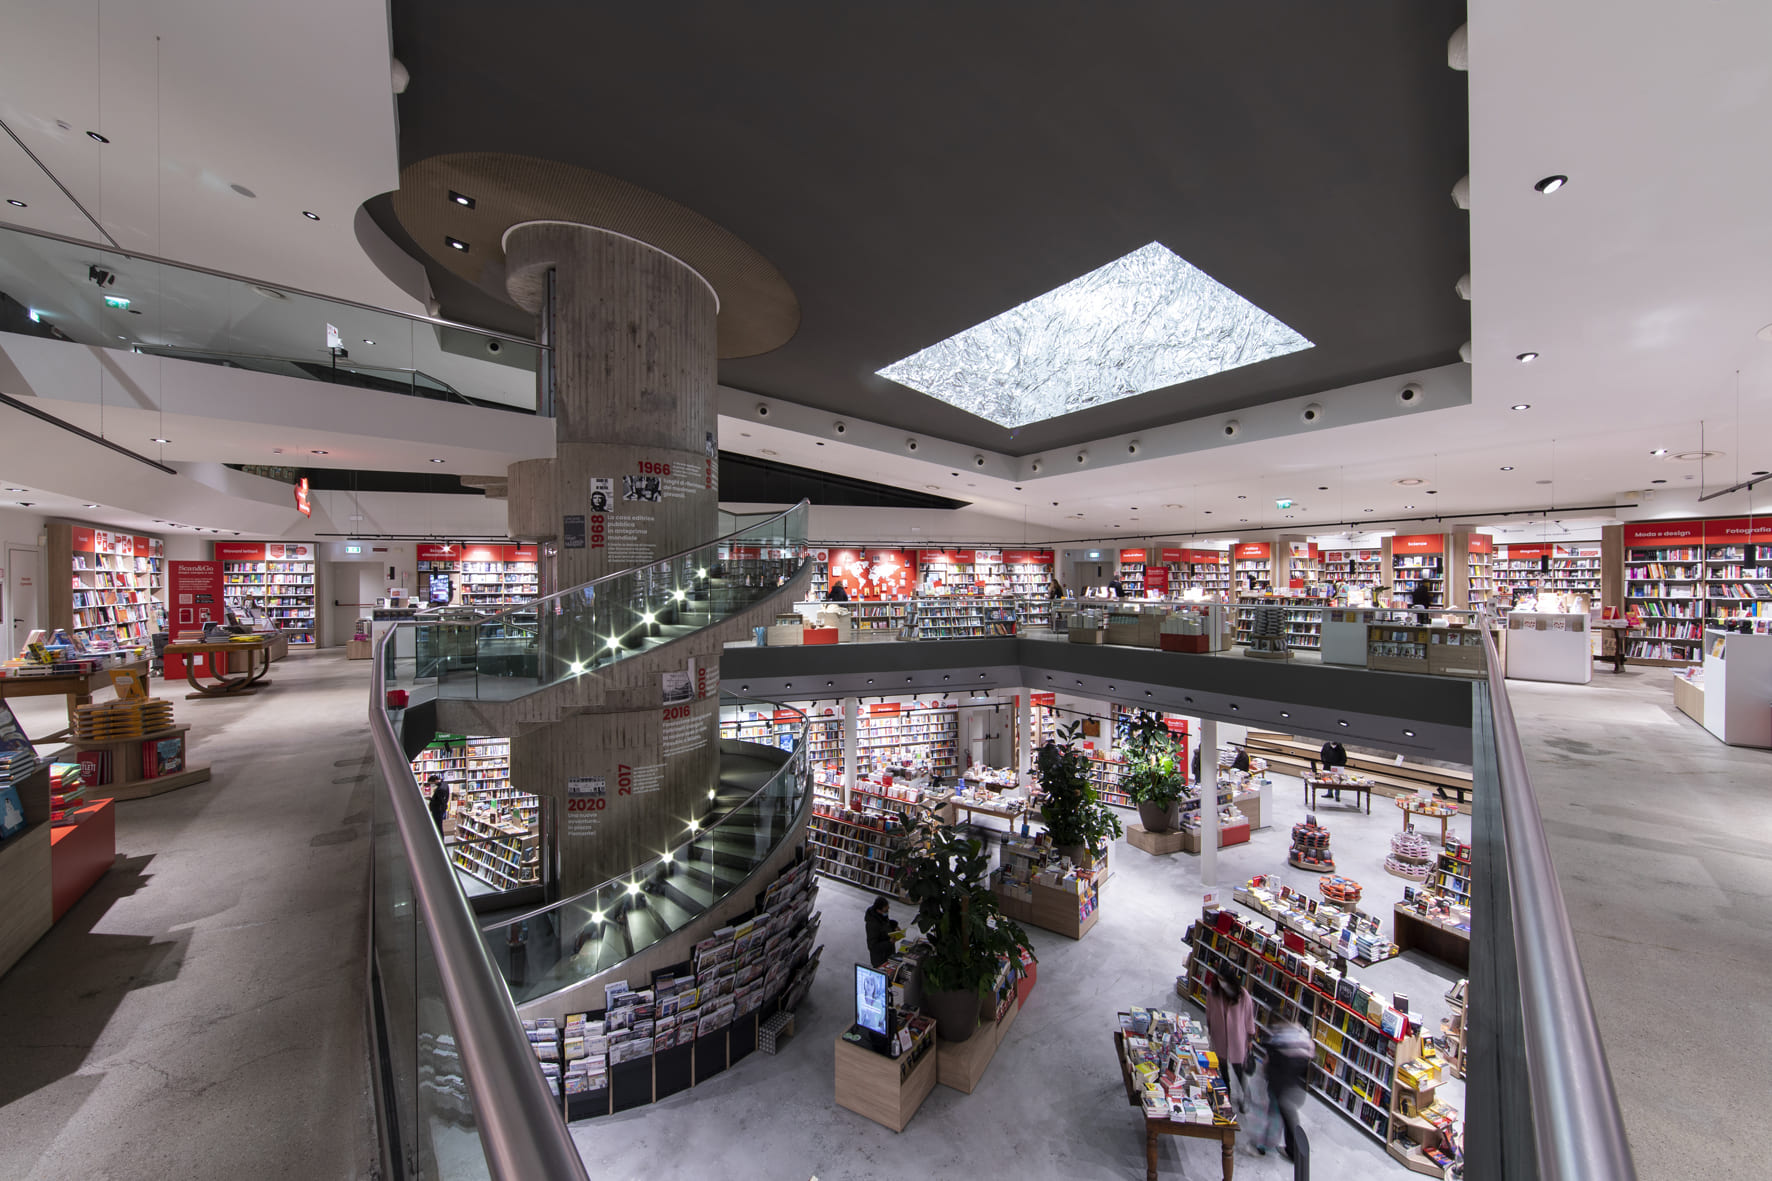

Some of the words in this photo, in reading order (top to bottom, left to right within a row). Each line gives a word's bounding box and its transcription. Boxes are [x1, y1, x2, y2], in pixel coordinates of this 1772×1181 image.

[638, 460, 671, 476] 1966
[592, 514, 604, 549] 1968
[1726, 526, 1772, 534] Fotografia
[698, 668, 706, 700] 2010
[662, 704, 690, 720] 2016
[618, 764, 632, 796] 2017
[568, 798, 606, 811] 2020
